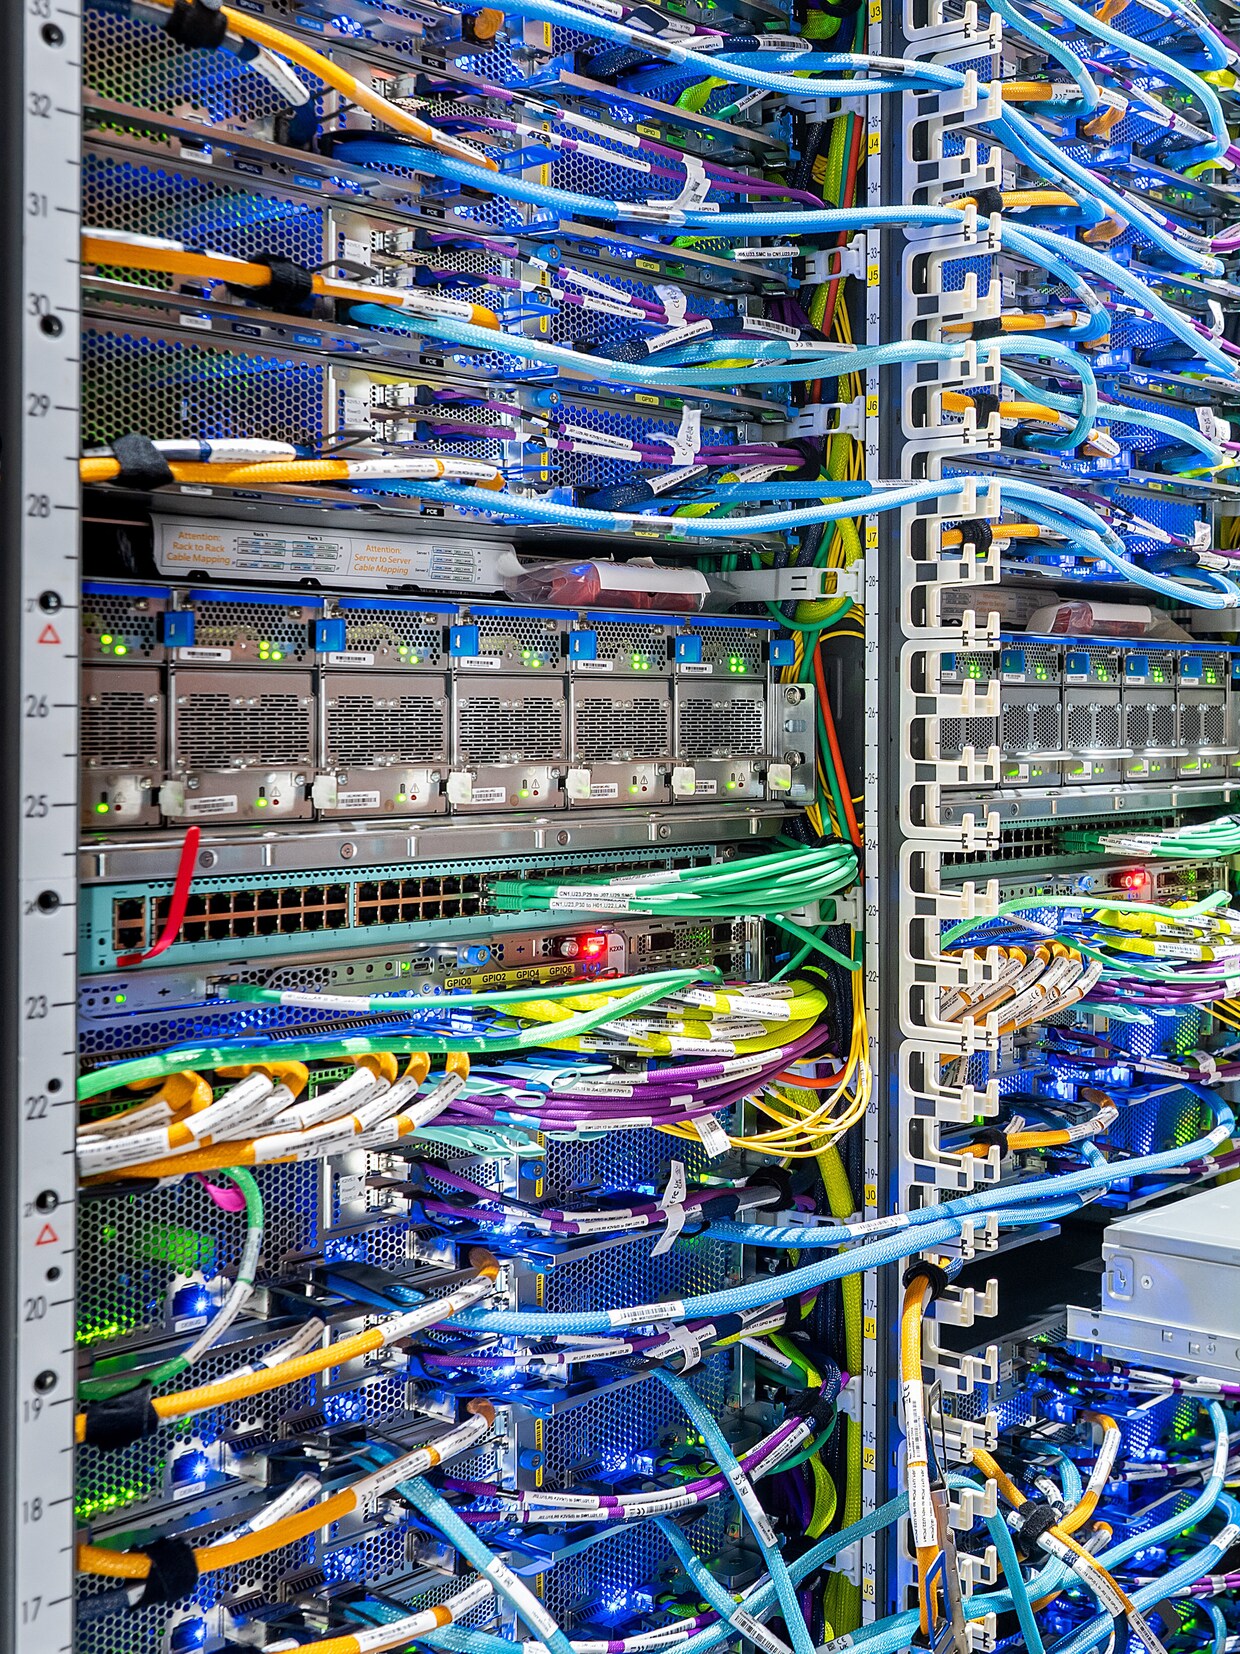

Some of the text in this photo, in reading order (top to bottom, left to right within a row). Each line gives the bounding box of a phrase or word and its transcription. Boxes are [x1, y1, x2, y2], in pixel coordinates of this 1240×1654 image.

[870, 6, 881, 18] J3
[28, 92, 51, 119] 32
[870, 116, 879, 127] 35
[869, 138, 879, 149] J4
[870, 182, 878, 193] 34
[28, 192, 48, 218] 31
[869, 248, 877, 258] 33
[642, 261, 655, 269] GPIO
[868, 271, 878, 281] J5
[28, 292, 51, 316] 30
[869, 313, 877, 324] 32
[869, 379, 876, 390] 31
[28, 392, 51, 418] 29
[867, 401, 877, 411] J6
[868, 444, 876, 456] 30
[27, 493, 51, 519] 28
[178, 531, 222, 541] Attention:
[867, 532, 877, 543] J7
[173, 542, 225, 553] Rack to Rack
[366, 544, 402, 554] Attention:
[166, 553, 231, 565] Cable Mapping
[354, 553, 411, 565] Server to Server
[353, 563, 409, 575] Cable Mapping
[868, 576, 876, 587] 28
[868, 641, 876, 652] 27
[26, 694, 50, 718] 26
[868, 707, 876, 718] 26
[868, 773, 876, 784] 25
[25, 795, 49, 818] 25
[867, 839, 876, 851] 24
[868, 905, 877, 916] 23
[516, 969, 540, 980] GPIO4
[549, 966, 573, 976] GPIO6
[868, 970, 877, 982] 22
[447, 977, 472, 988] GPIO0
[482, 973, 506, 984] GPIO2
[26, 995, 49, 1019] 23
[868, 1036, 876, 1048] 21
[25, 1095, 49, 1119] 22
[868, 1102, 876, 1114] 20
[867, 1169, 875, 1179] 19
[866, 1191, 876, 1201] J0
[24, 1296, 47, 1321] 20
[866, 1300, 874, 1311] 17
[865, 1322, 875, 1333] J1
[866, 1365, 874, 1377] 16
[23, 1398, 43, 1423] 19
[865, 1431, 874, 1443] 15
[865, 1454, 874, 1465] J2
[865, 1497, 873, 1509] 14
[23, 1497, 42, 1524] 18
[865, 1564, 873, 1575] 13
[864, 1585, 874, 1596] J3
[22, 1597, 42, 1624] 17
